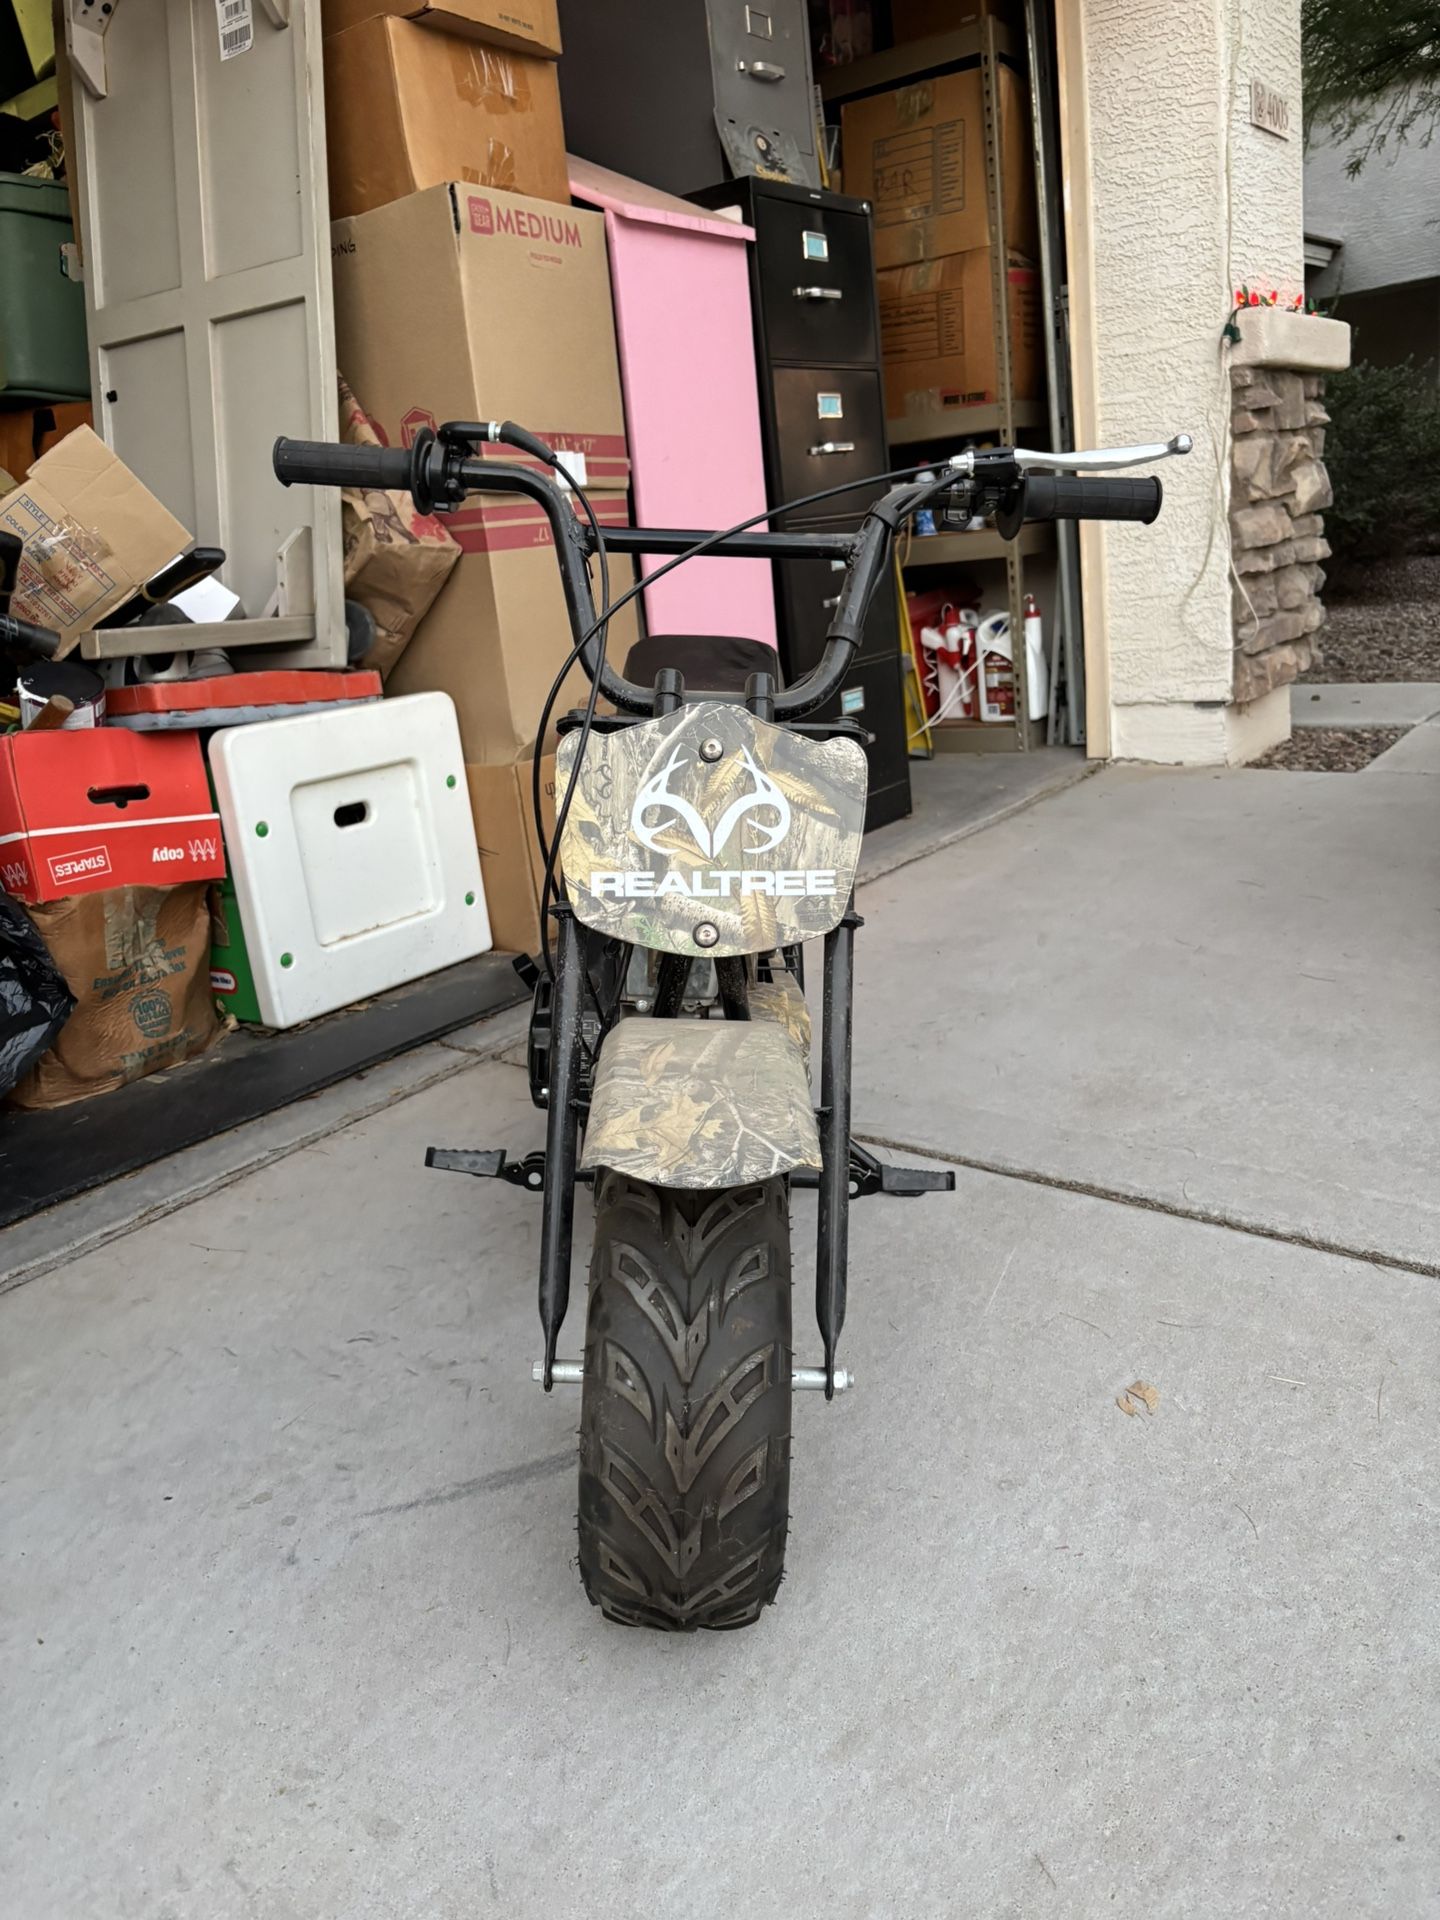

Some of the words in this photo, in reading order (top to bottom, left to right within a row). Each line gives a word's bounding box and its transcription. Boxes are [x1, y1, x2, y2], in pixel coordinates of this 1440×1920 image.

[496, 205, 582, 248] MEDIUM
[23, 500, 45, 521] STYLE
[4, 514, 29, 538] COLOR
[55, 854, 106, 878] STAPLES
[152, 847, 184, 863] copy
[590, 869, 837, 898] REALTREE
